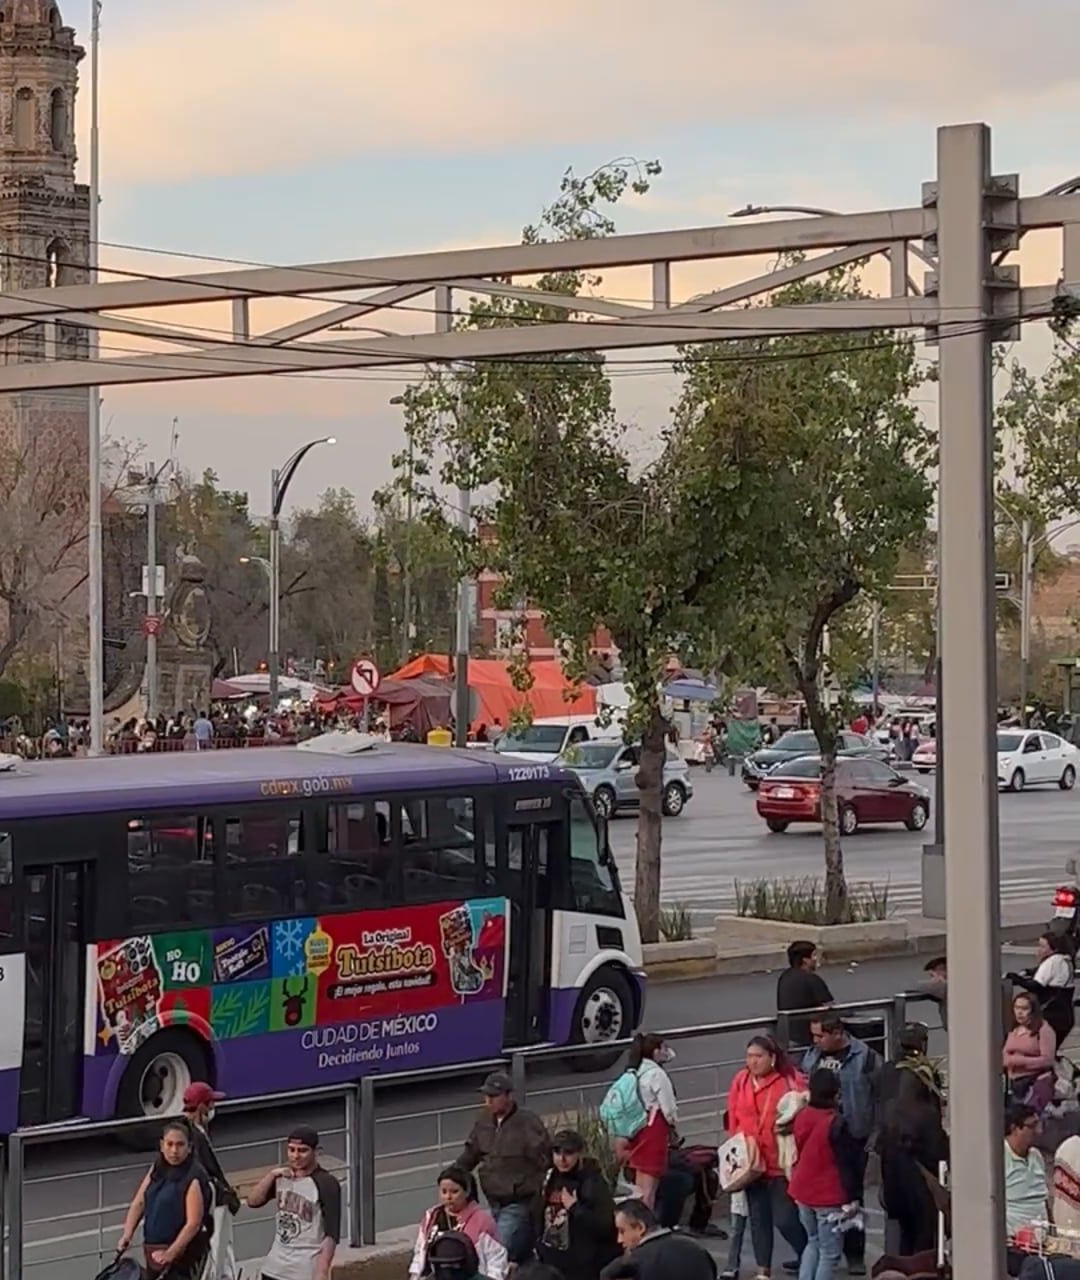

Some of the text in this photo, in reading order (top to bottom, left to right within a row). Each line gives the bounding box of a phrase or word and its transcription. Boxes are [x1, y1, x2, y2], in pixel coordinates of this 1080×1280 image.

[508, 766, 549, 781] 1220173
[260, 775, 353, 796] cdmx.gob.mx
[363, 929, 410, 944] La Original
[166, 949, 182, 961] HO
[337, 945, 434, 978] Tutsibota
[171, 961, 200, 982] HO
[301, 1013, 438, 1049] CIUDAD DE MÉXICO
[318, 1041, 420, 1068] Decidiendo Juntos
